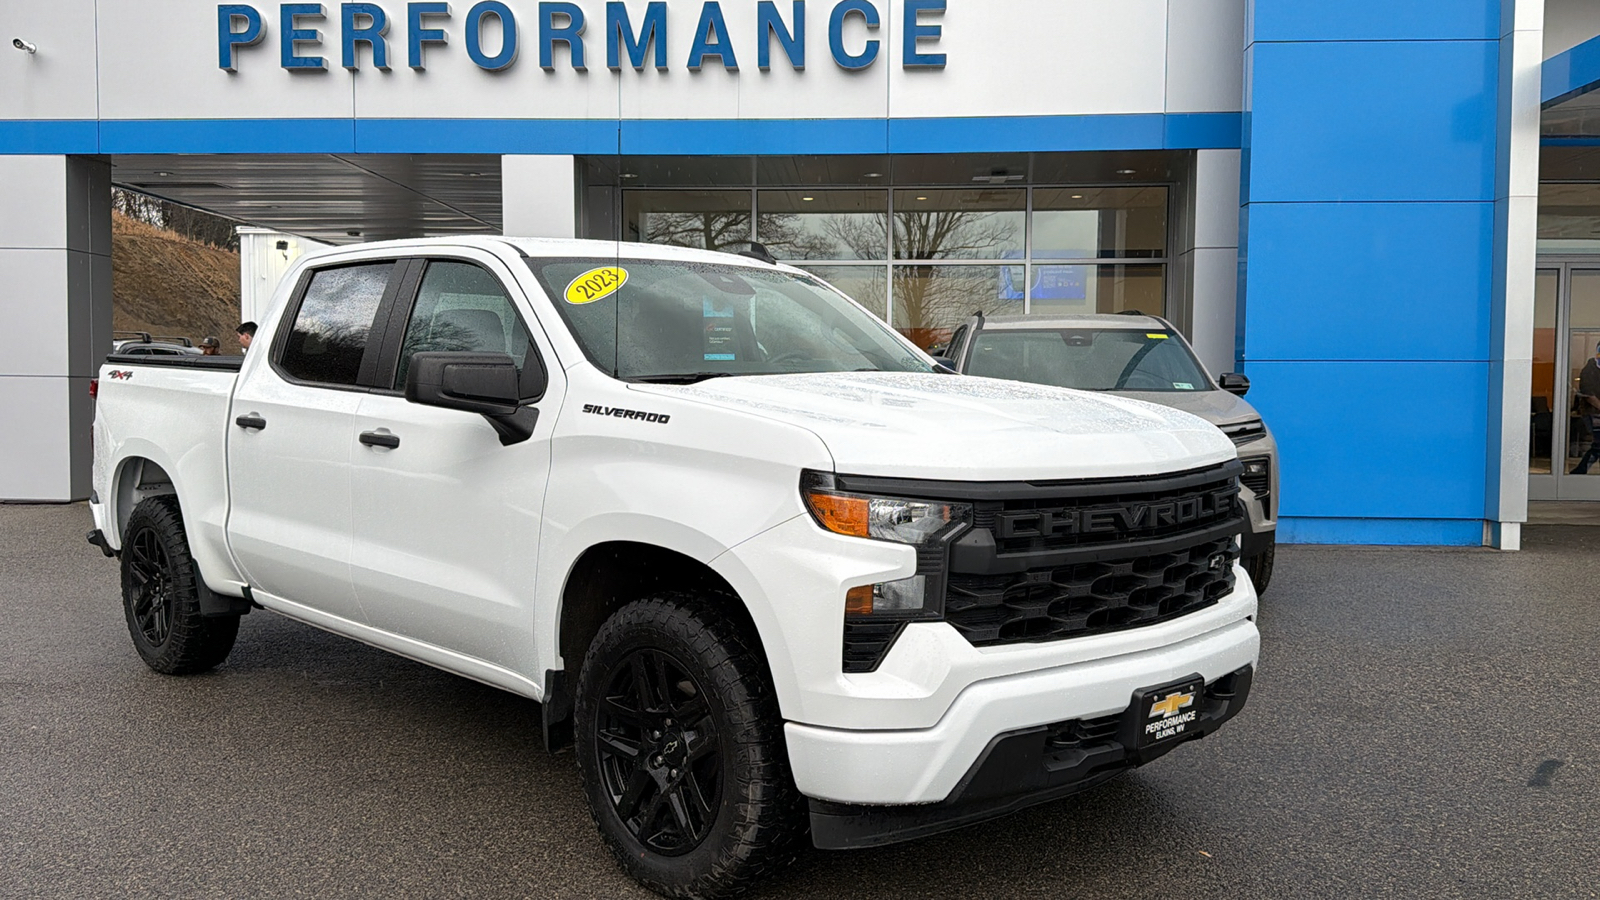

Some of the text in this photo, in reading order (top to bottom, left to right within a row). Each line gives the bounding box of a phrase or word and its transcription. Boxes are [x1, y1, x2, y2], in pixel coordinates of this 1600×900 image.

[218, 0, 947, 74] PERFORMANCE
[575, 269, 620, 299] 2023
[582, 403, 671, 425] SILVERADO
[1145, 710, 1196, 734] PERFORMANCE
[1176, 724, 1185, 732] WV
